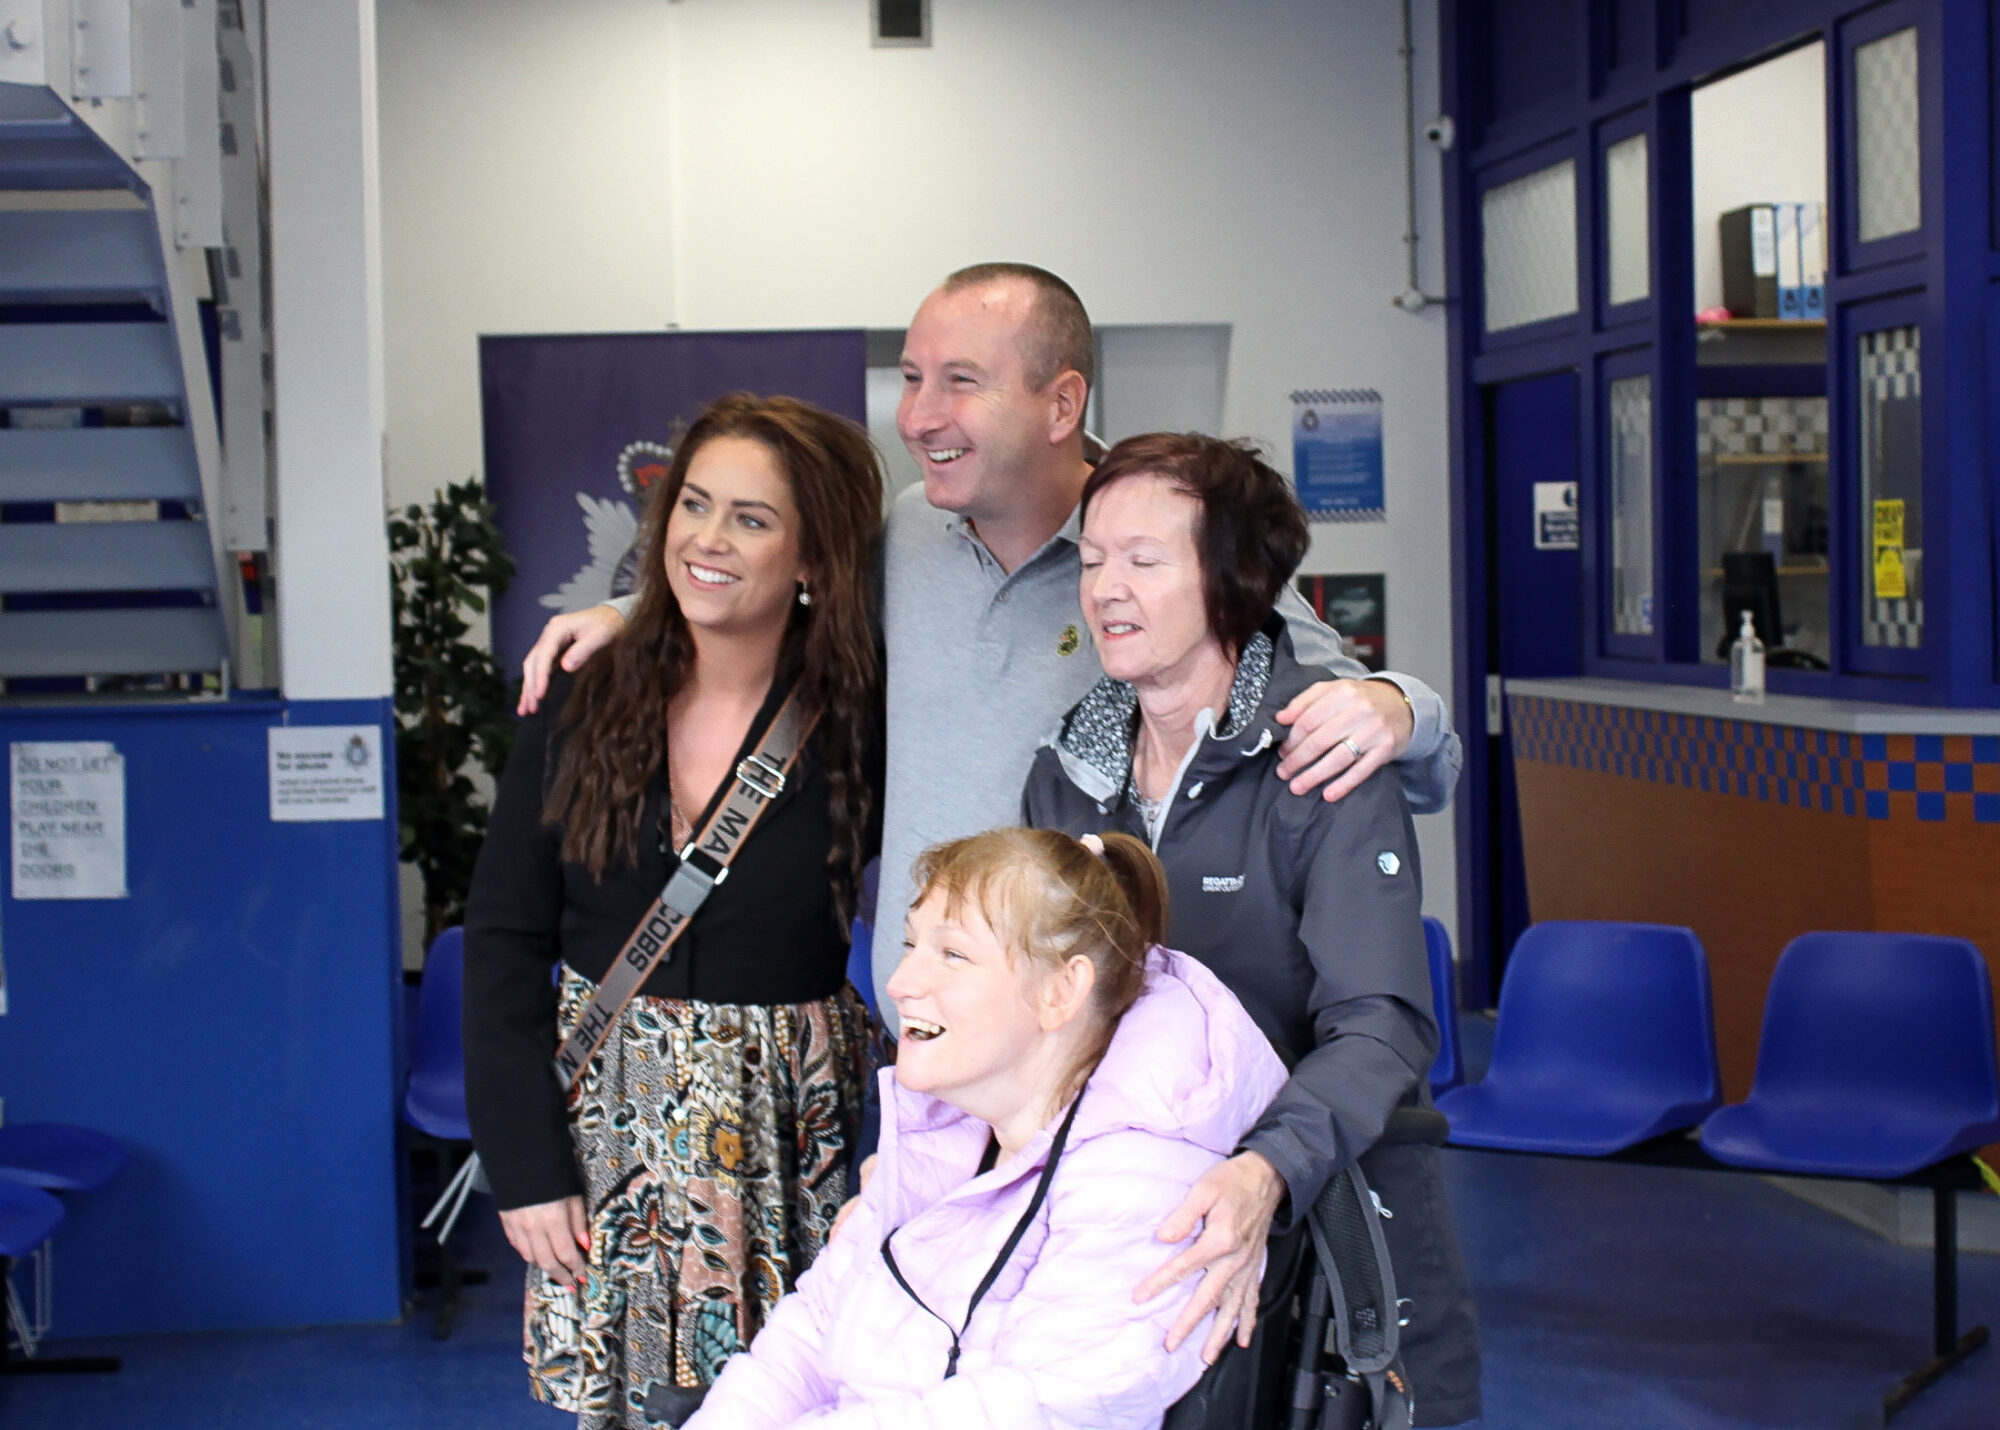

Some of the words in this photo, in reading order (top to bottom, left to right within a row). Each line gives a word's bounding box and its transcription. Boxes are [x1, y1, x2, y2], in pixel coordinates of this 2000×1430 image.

[739, 751, 787, 804] THE
[18, 800, 98, 816] CHILDREN
[61, 821, 104, 837] NEAR
[575, 1003, 615, 1053] THE
